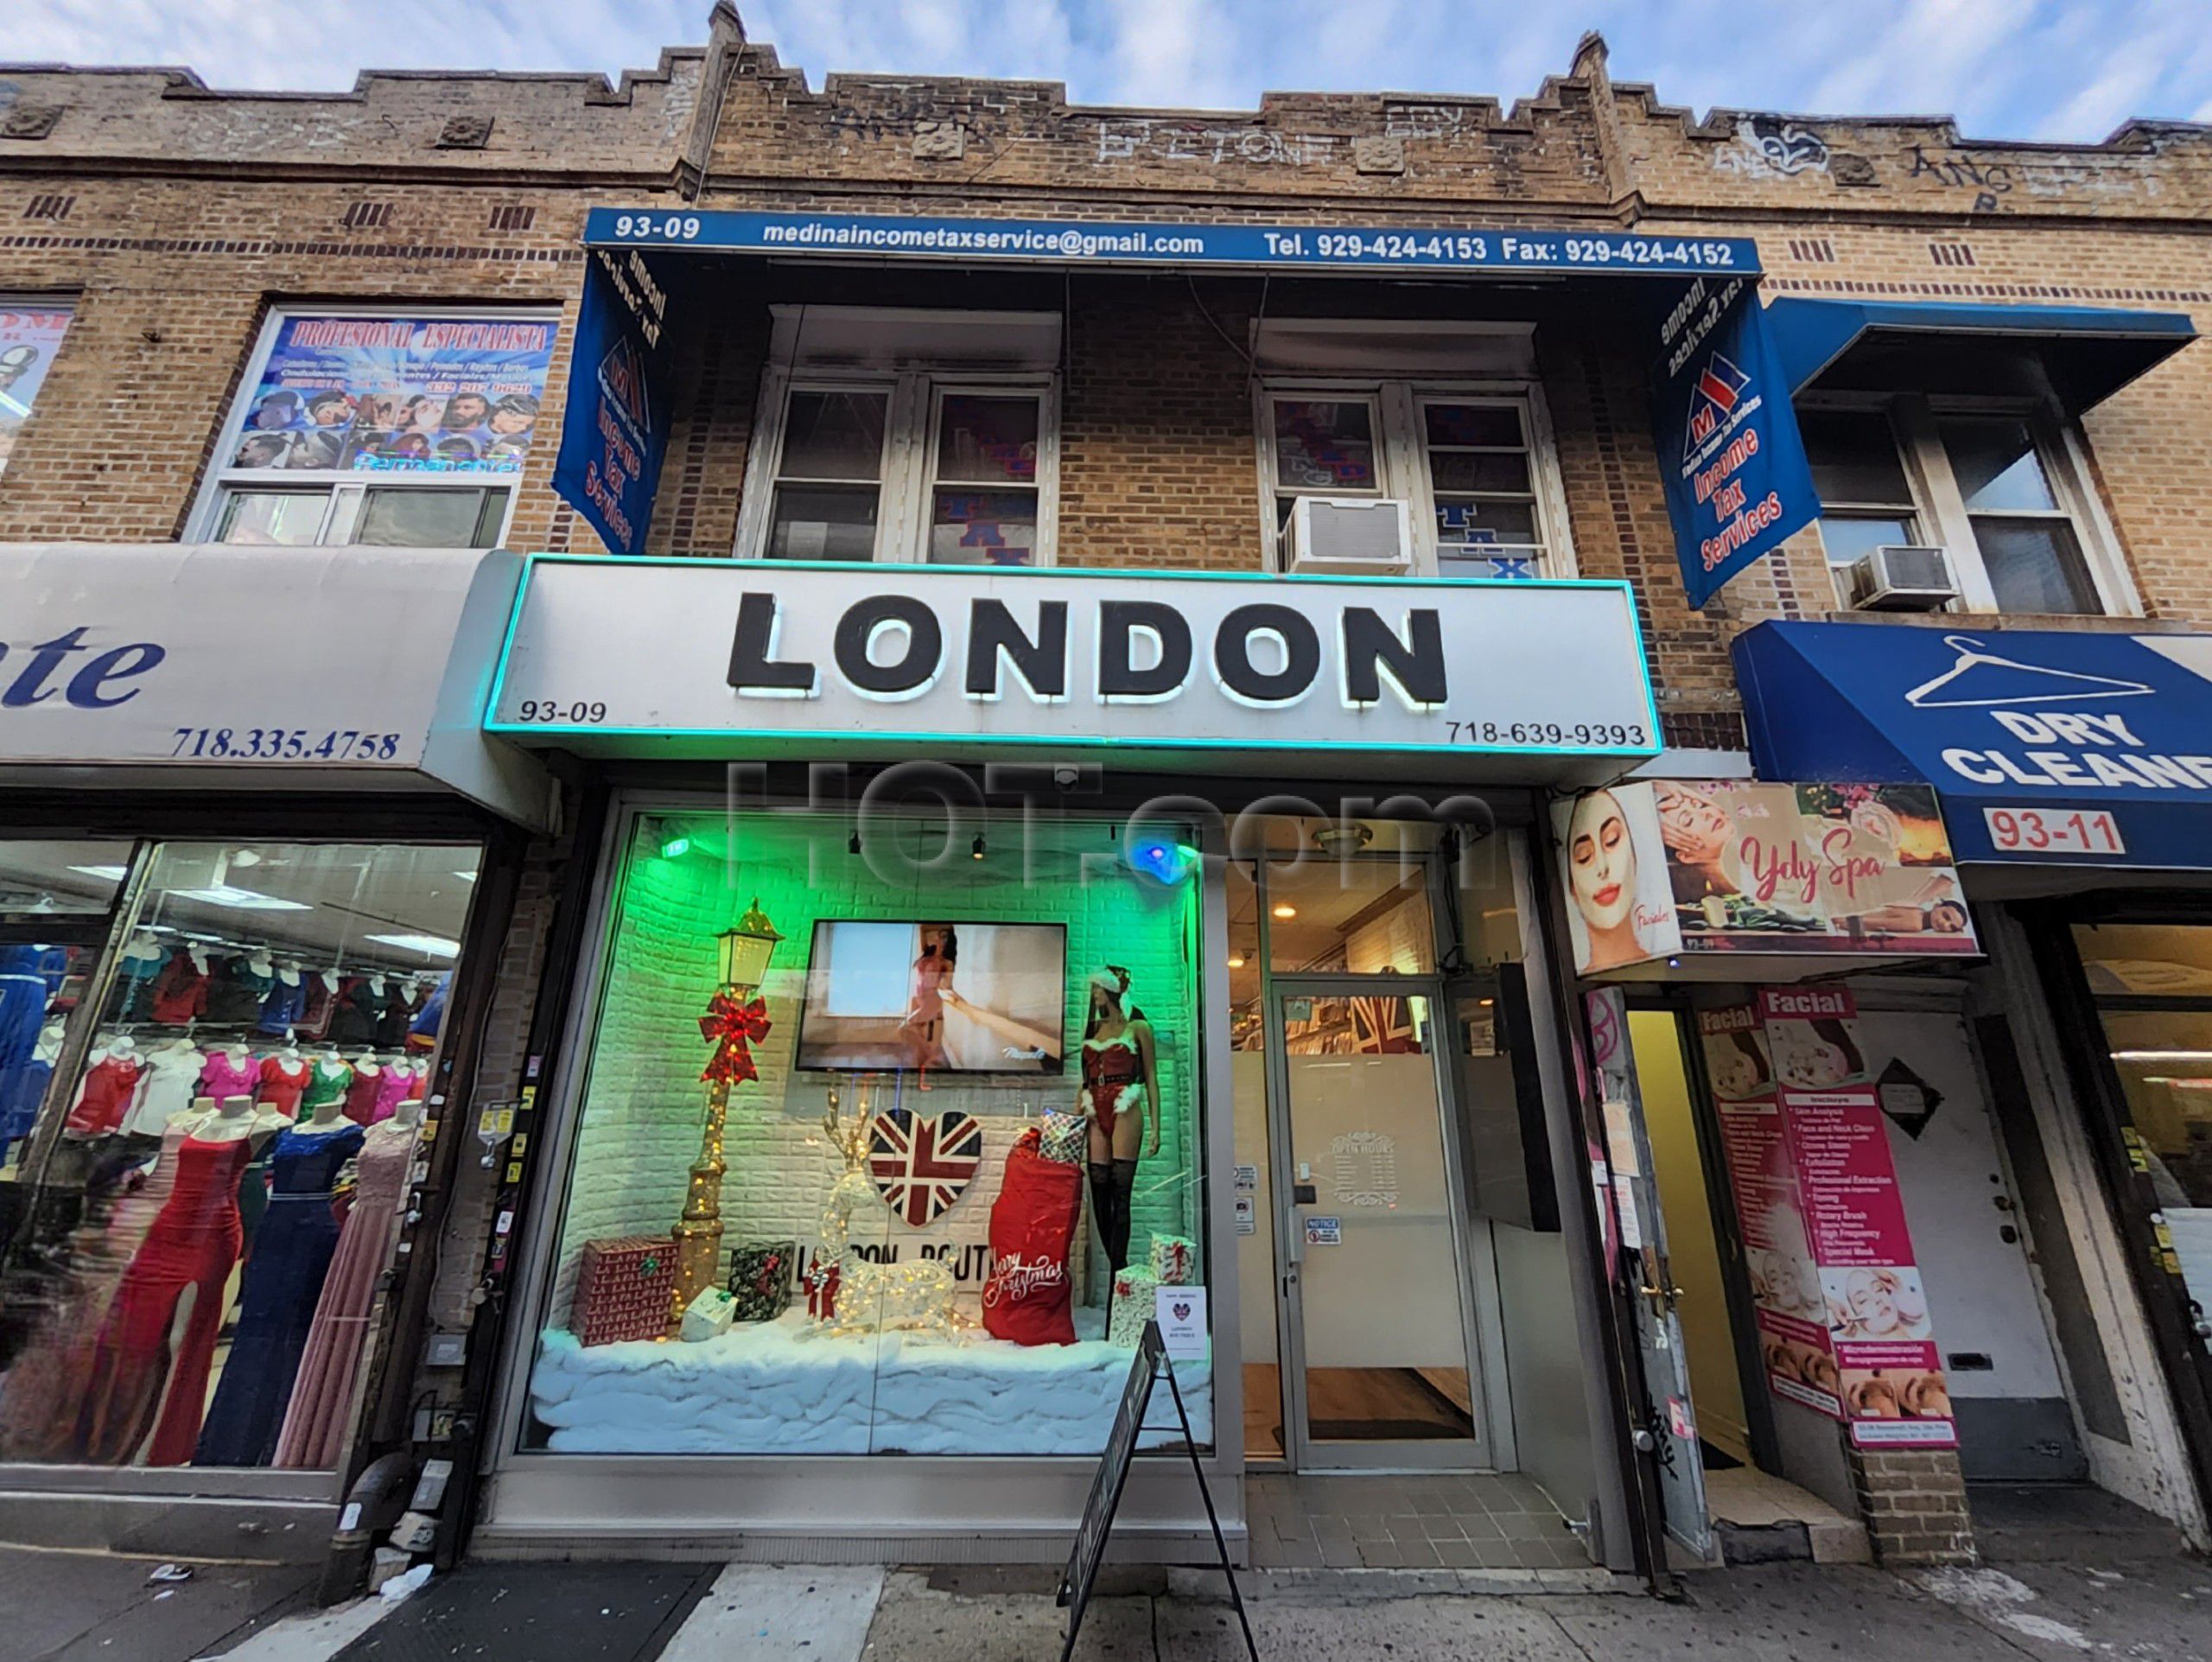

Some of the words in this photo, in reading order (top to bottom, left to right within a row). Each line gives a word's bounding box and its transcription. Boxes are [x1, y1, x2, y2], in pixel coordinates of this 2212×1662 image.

[614, 215, 701, 239] 93-09
[763, 223, 1205, 256] medinaincometaxservice@gmail.com
[1264, 232, 1310, 257] Tel.
[1317, 234, 1488, 259] 929-424-4153
[1502, 237, 1559, 262] Fax:
[1565, 239, 1734, 264] 929-424-4152
[1693, 427, 1759, 506] Income
[1711, 477, 1747, 524] Tax
[0, 626, 167, 709] te
[726, 591, 1448, 710] LONDON
[518, 698, 607, 724] 93-09
[1989, 710, 2145, 747] DRY
[171, 728, 402, 761] 718.335.4758
[1445, 721, 1646, 747] 718-639-9393
[1991, 810, 2118, 851] 93-11
[1821, 827, 1886, 900] Spa
[1701, 1006, 1755, 1032] Facial
[1767, 992, 1847, 1014] Facial
[1308, 1219, 1338, 1229] NOTICE
